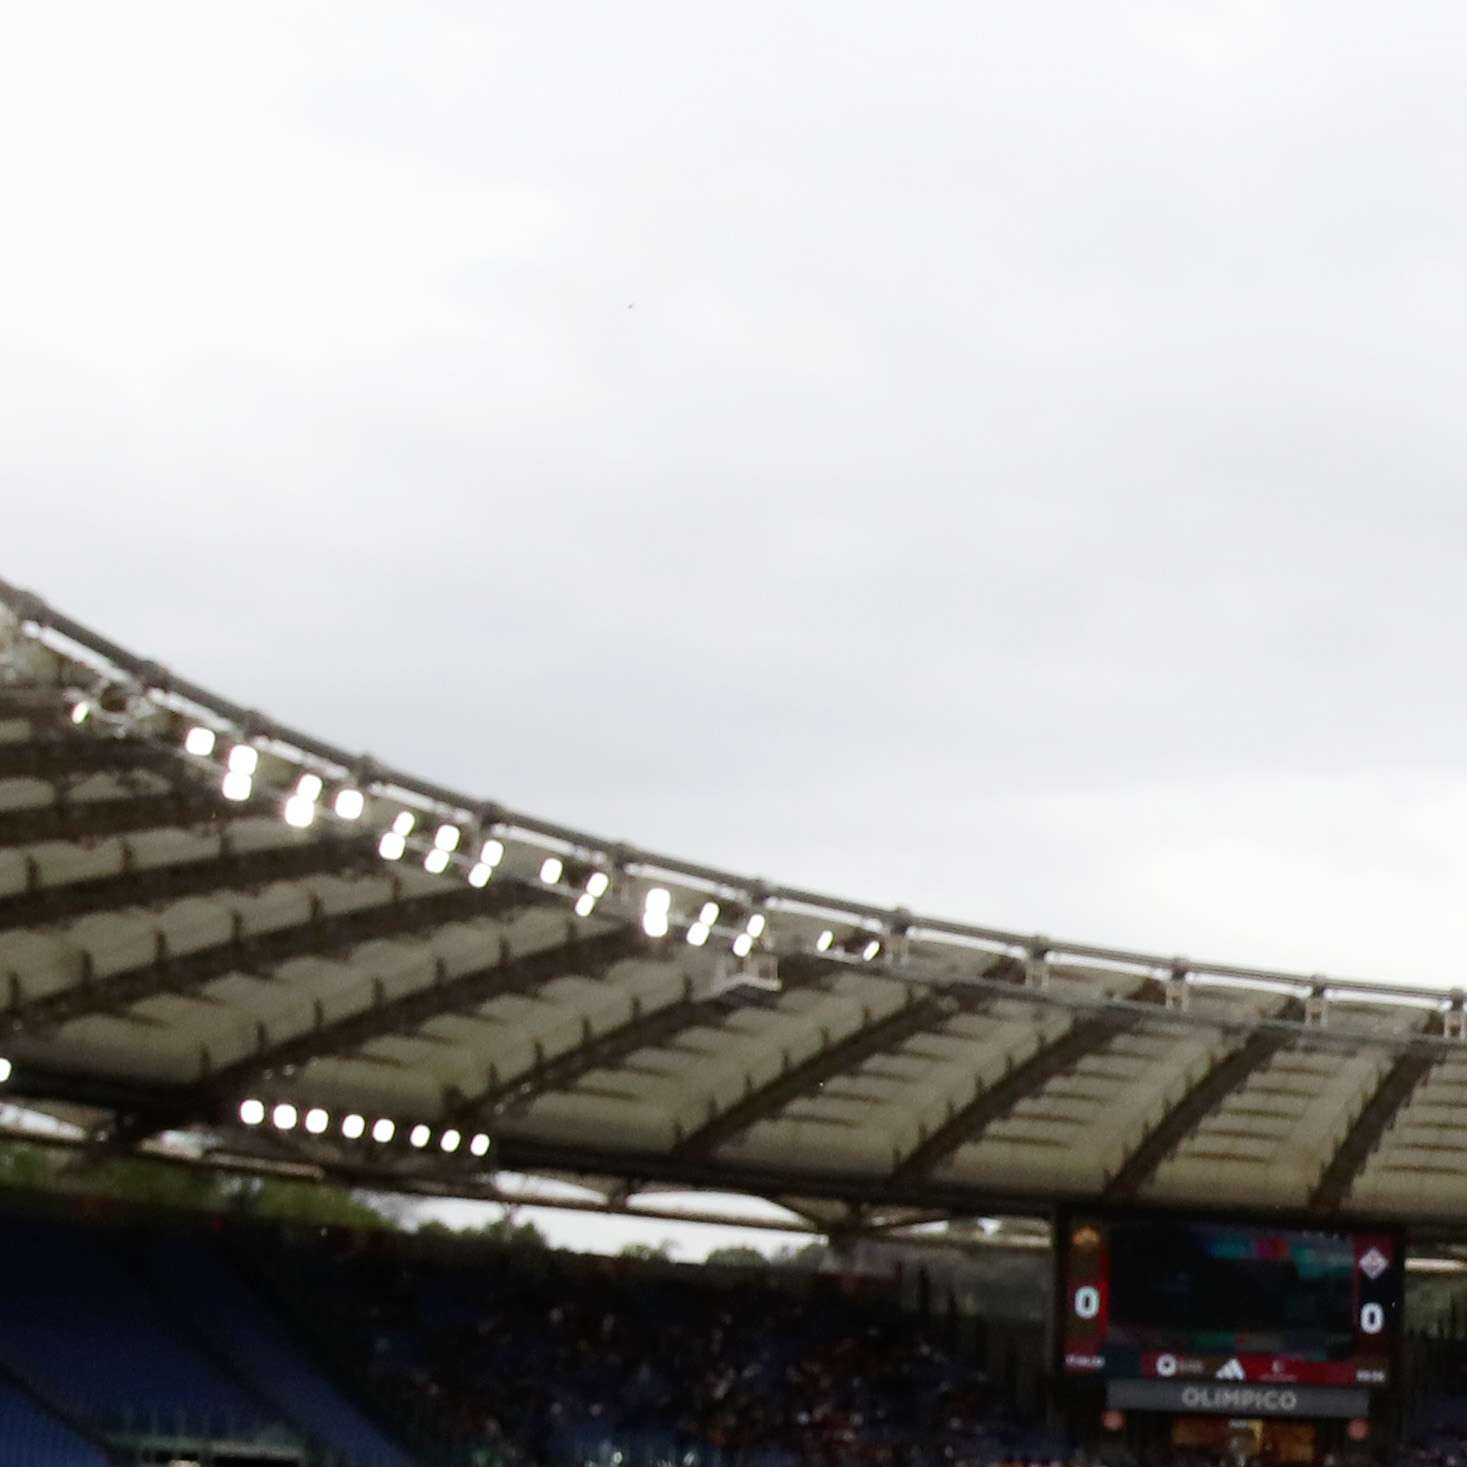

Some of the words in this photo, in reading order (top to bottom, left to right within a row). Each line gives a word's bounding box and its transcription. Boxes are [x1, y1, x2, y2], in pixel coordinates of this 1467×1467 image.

[1074, 1285, 1100, 1319] 0
[1360, 1303, 1384, 1334] 0
[1182, 1386, 1298, 1411] OLIMPICO
